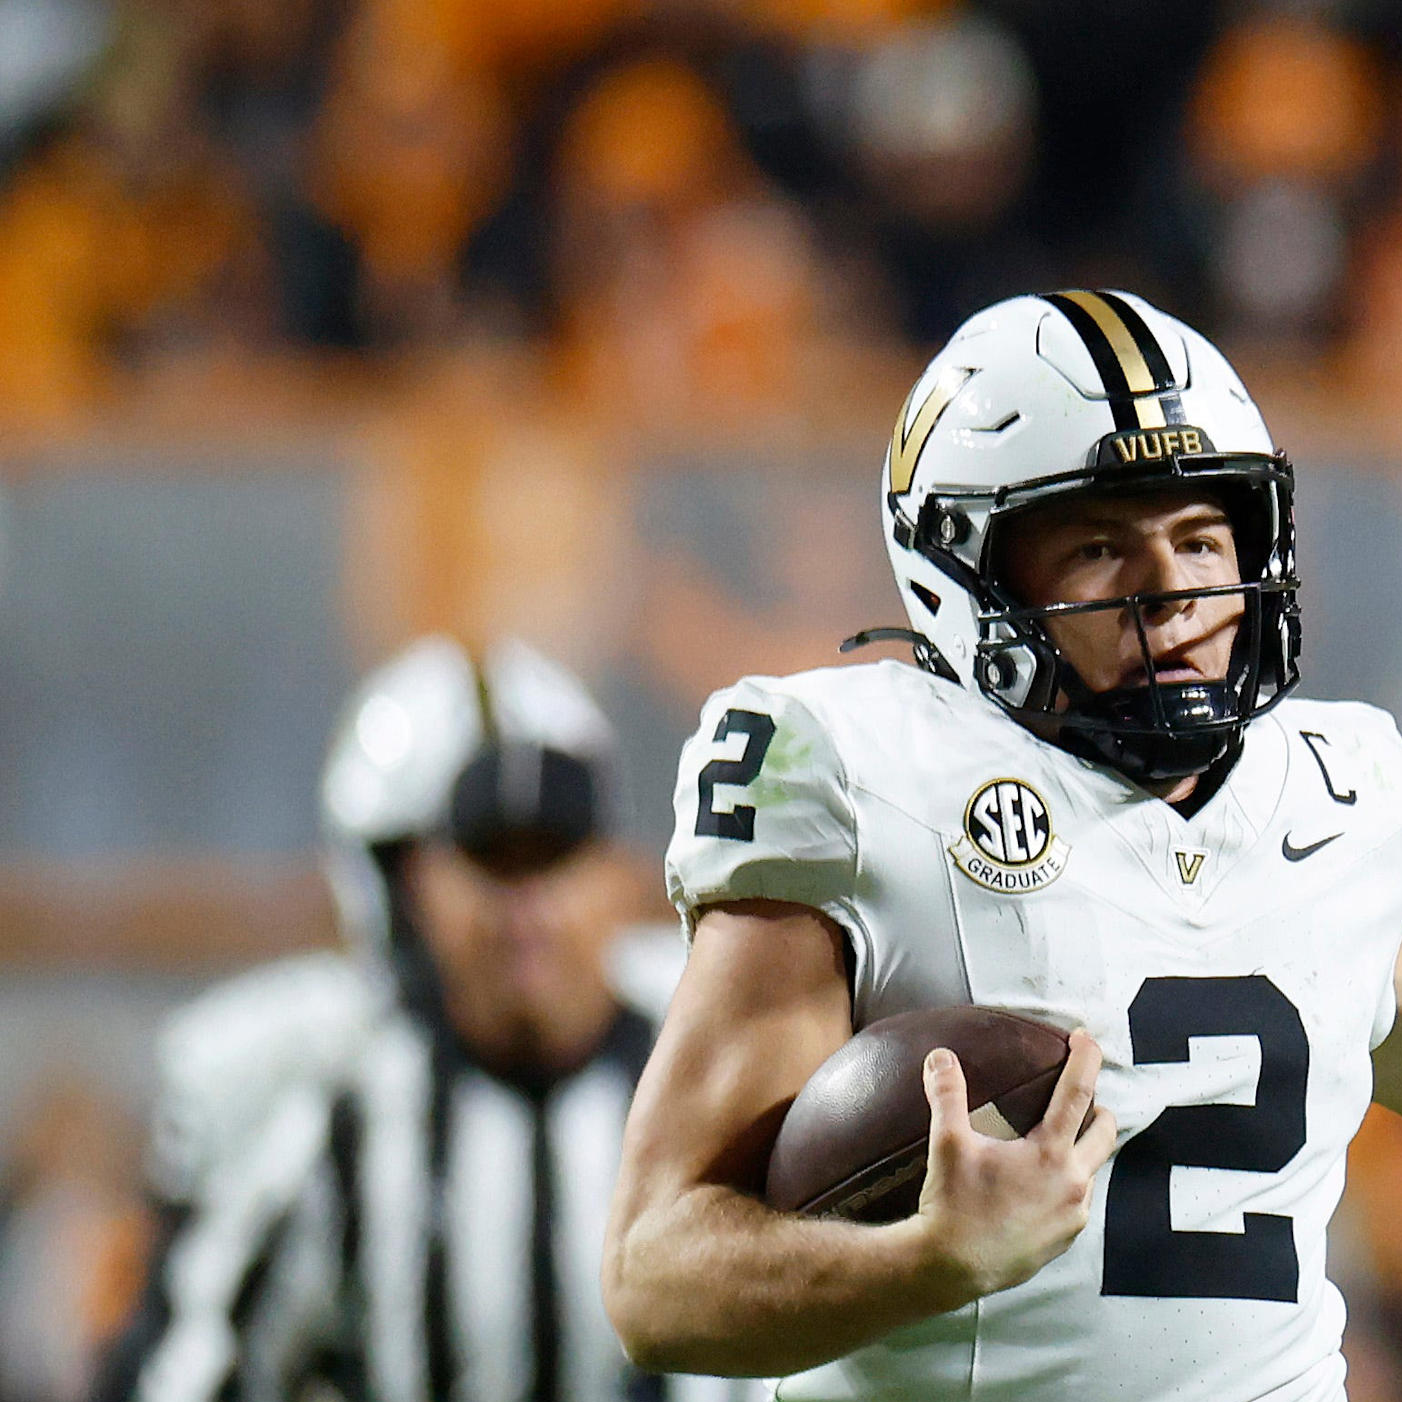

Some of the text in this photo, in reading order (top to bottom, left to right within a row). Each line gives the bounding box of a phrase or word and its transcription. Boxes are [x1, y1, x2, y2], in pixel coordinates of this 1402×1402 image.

[889, 367, 983, 495] V
[1115, 430, 1203, 463] VUFB
[694, 708, 777, 843] 2
[973, 782, 1047, 862] SEC
[967, 858, 1061, 889] GRADUATE
[1175, 852, 1206, 884] V
[1100, 974, 1310, 1304] 2
